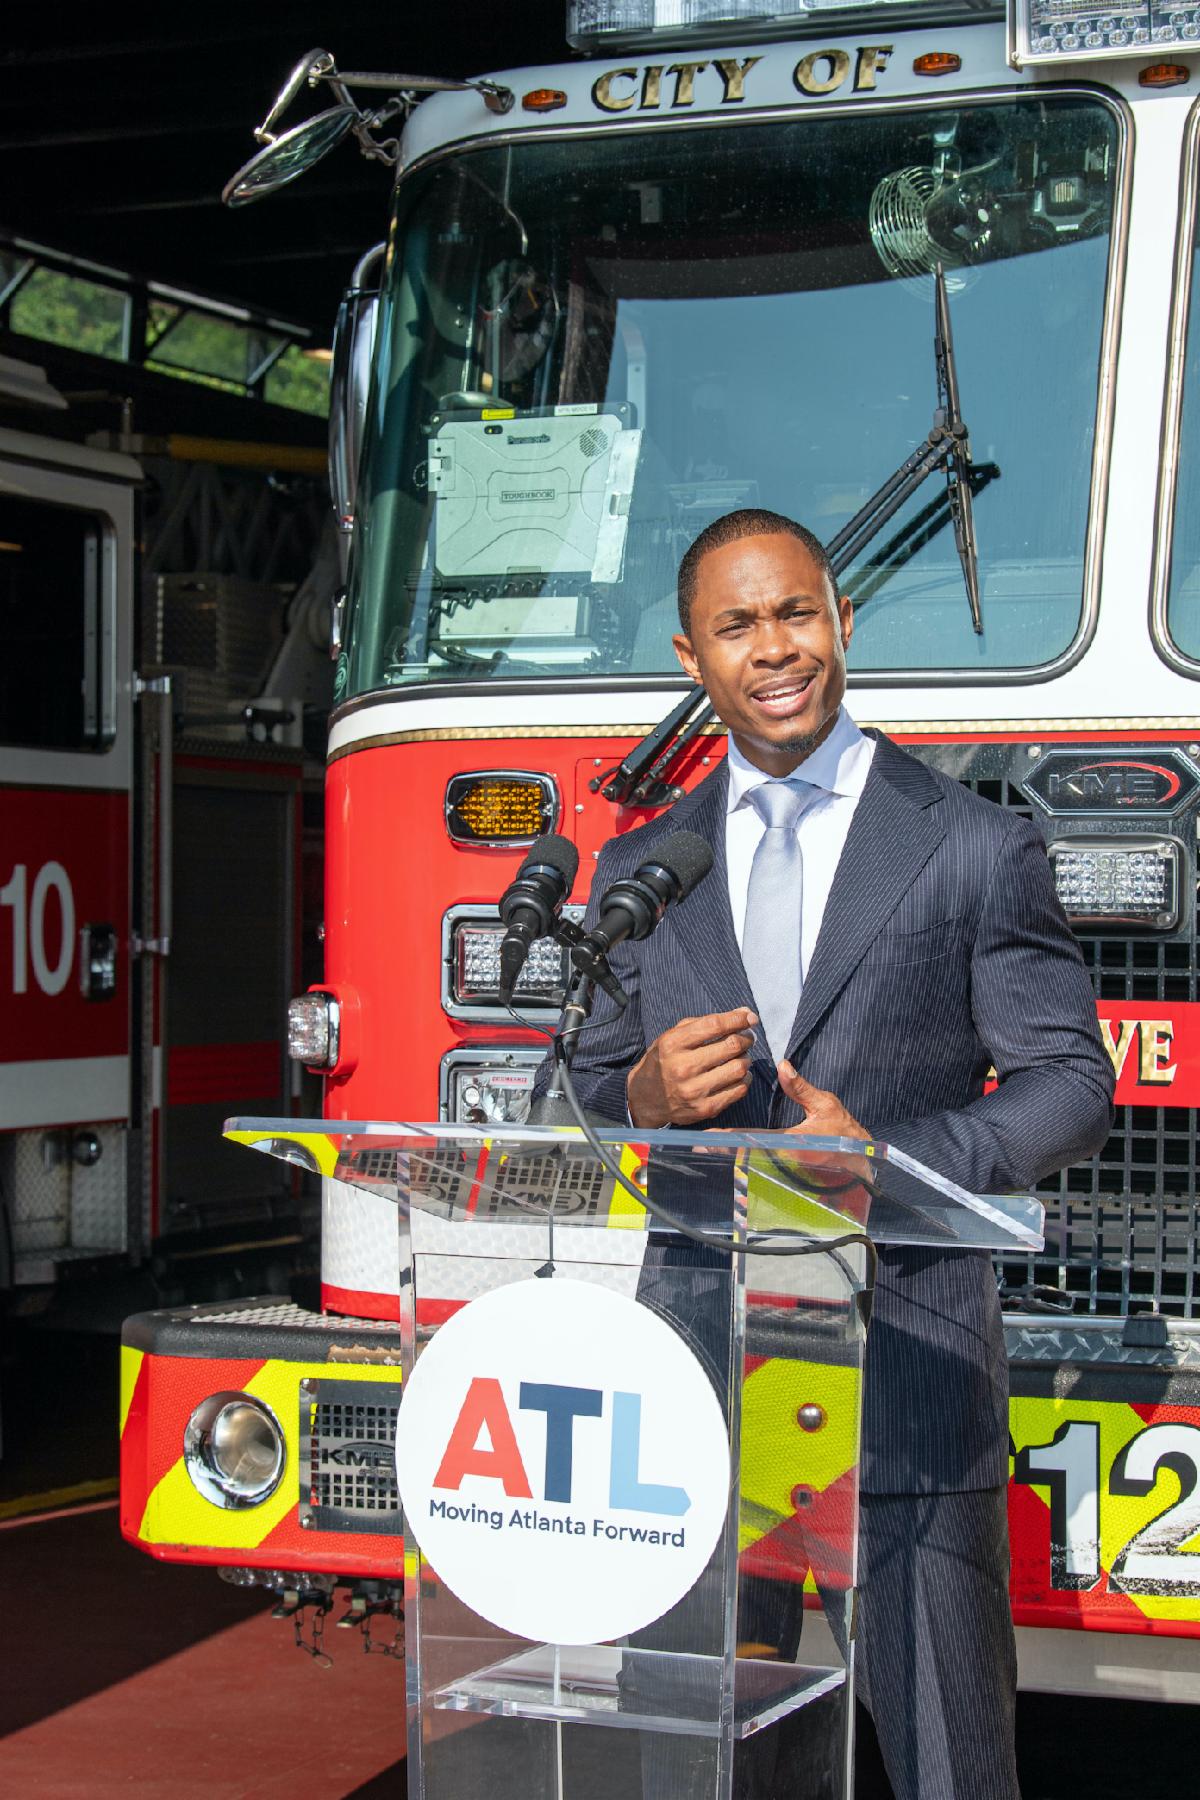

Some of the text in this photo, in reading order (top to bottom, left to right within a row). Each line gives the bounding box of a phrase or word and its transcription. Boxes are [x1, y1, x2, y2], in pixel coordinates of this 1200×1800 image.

[591, 45, 893, 112] CITY OF
[503, 490, 553, 501] TOUGHBOOK
[1048, 773, 1156, 795] KME
[0, 861, 75, 996] 10
[1098, 1019, 1178, 1087] VE
[321, 1448, 393, 1468] KME
[432, 1377, 692, 1517] ATL
[429, 1499, 686, 1548] Moving Atlanta Forward
[1014, 1420, 1200, 1595] 12
